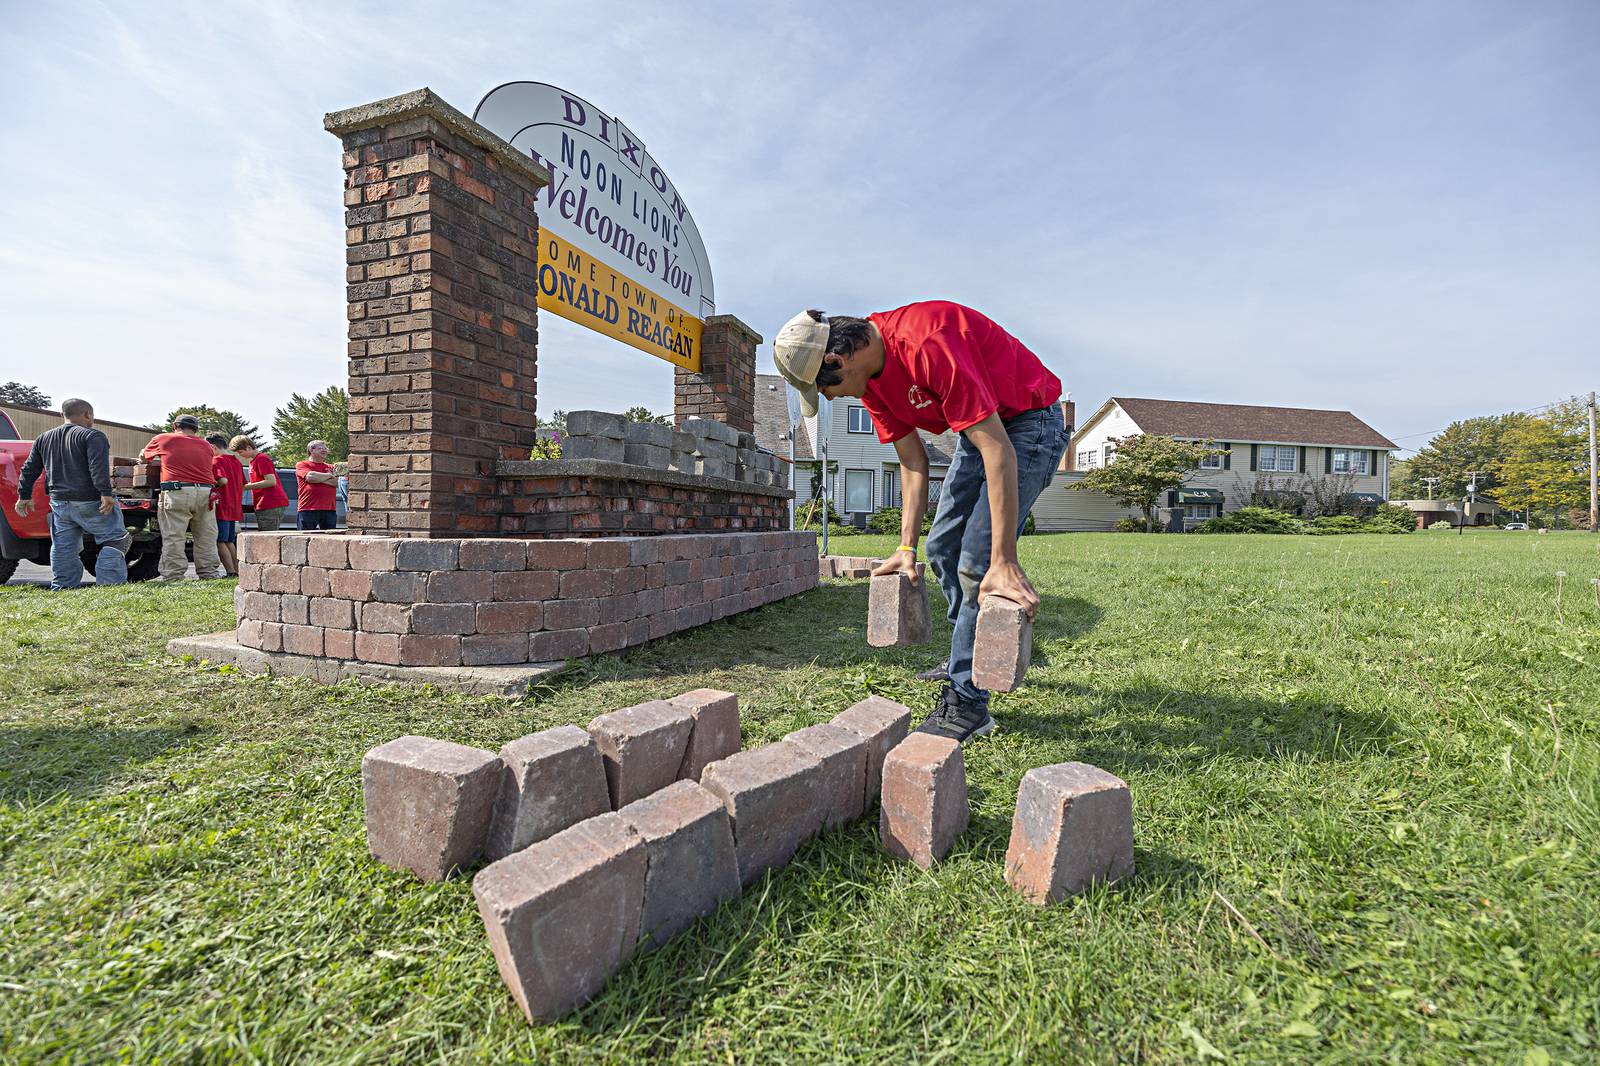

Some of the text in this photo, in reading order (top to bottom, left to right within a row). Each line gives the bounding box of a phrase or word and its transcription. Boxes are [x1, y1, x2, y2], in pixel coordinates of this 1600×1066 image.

[561, 95, 686, 223] DIXON
[561, 131, 680, 249] NOON LIONS
[530, 147, 693, 298] Welcomes You
[549, 240, 596, 282] OME
[610, 274, 657, 315] TOWN
[538, 263, 694, 360] ONALD REAGAN
